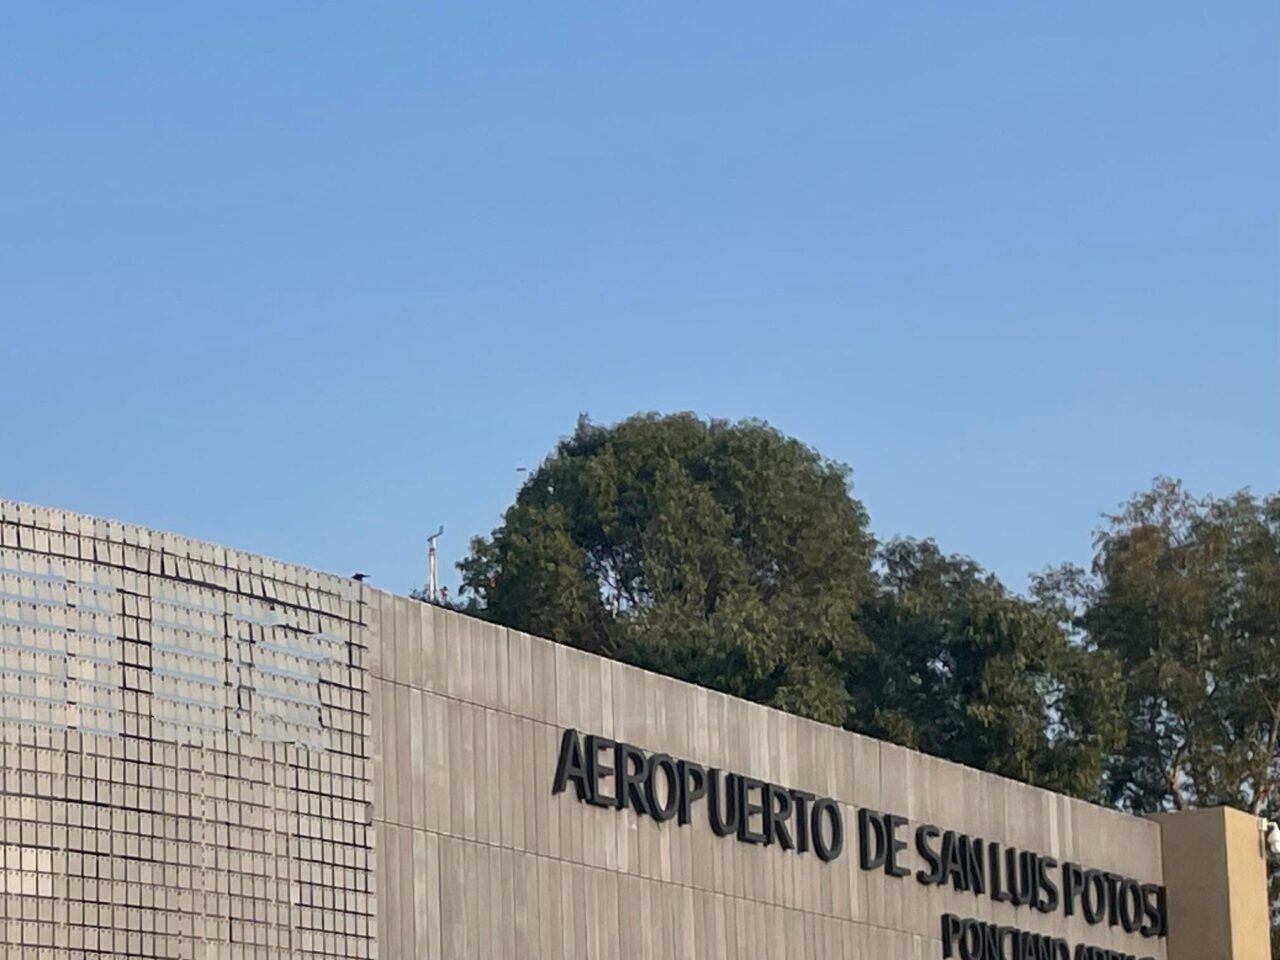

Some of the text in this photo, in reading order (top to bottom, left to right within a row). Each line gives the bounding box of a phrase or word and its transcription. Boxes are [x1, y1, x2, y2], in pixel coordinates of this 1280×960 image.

[552, 728, 843, 862] AEROPUERTO
[858, 808, 911, 877] DE
[916, 824, 985, 895] SAN
[989, 842, 1058, 914] LUIS
